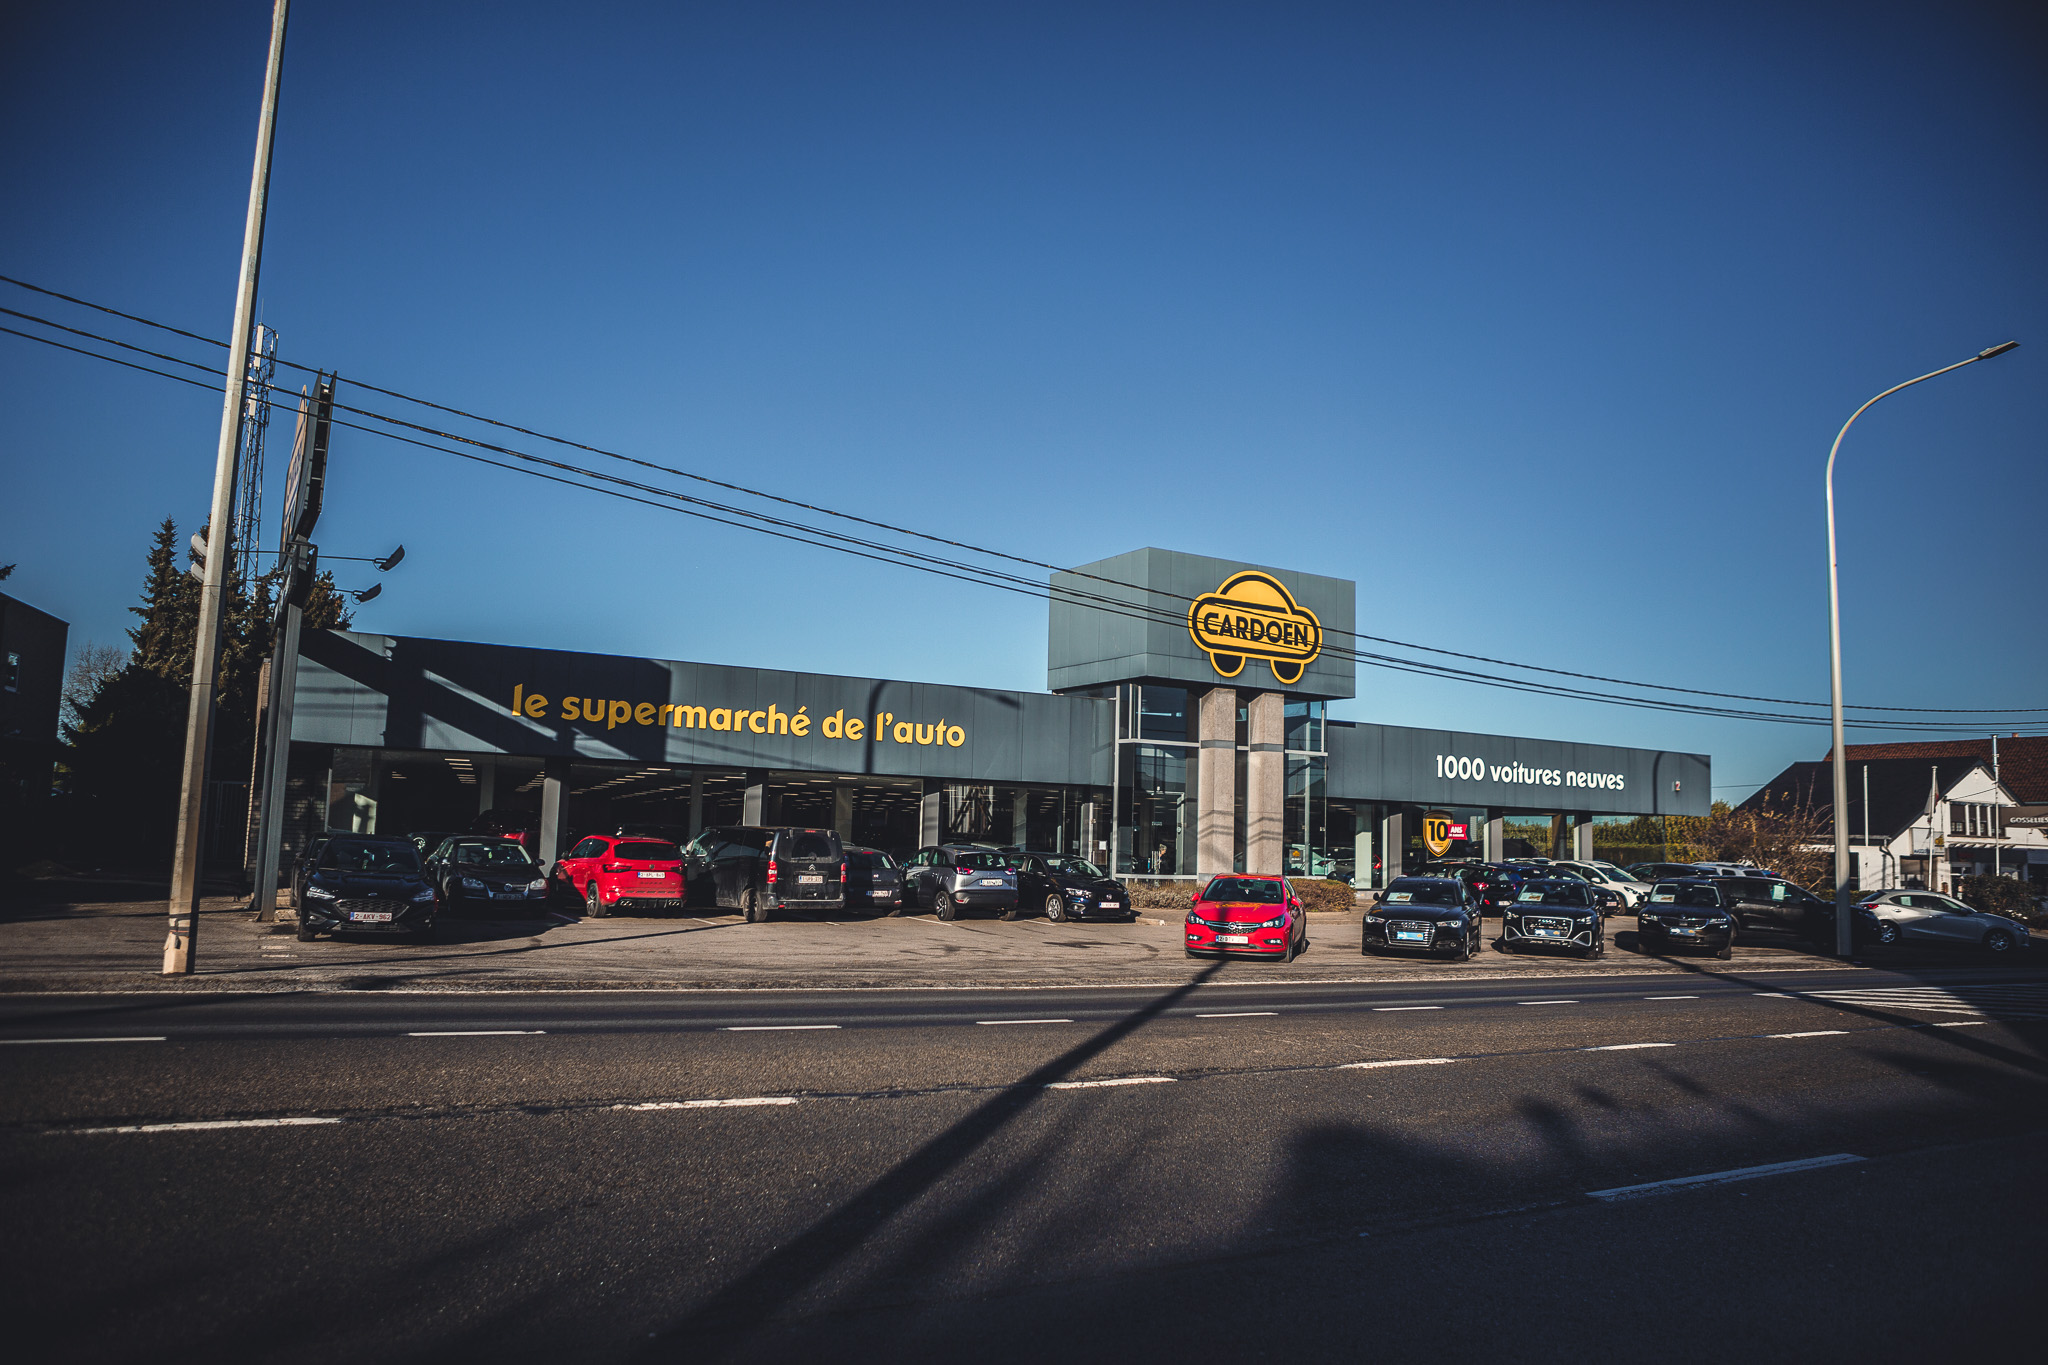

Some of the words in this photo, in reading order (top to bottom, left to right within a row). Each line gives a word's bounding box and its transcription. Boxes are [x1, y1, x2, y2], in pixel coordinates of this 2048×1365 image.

[1203, 611, 1308, 648] CARDOEN
[511, 683, 549, 718] le
[560, 696, 811, 737] supermarché
[821, 708, 865, 741] de
[875, 711, 966, 748] l'auto
[1436, 754, 1486, 782] 1000
[1490, 760, 1562, 787] voitures
[1566, 770, 1625, 791] neuves
[1428, 820, 1449, 842] 10
